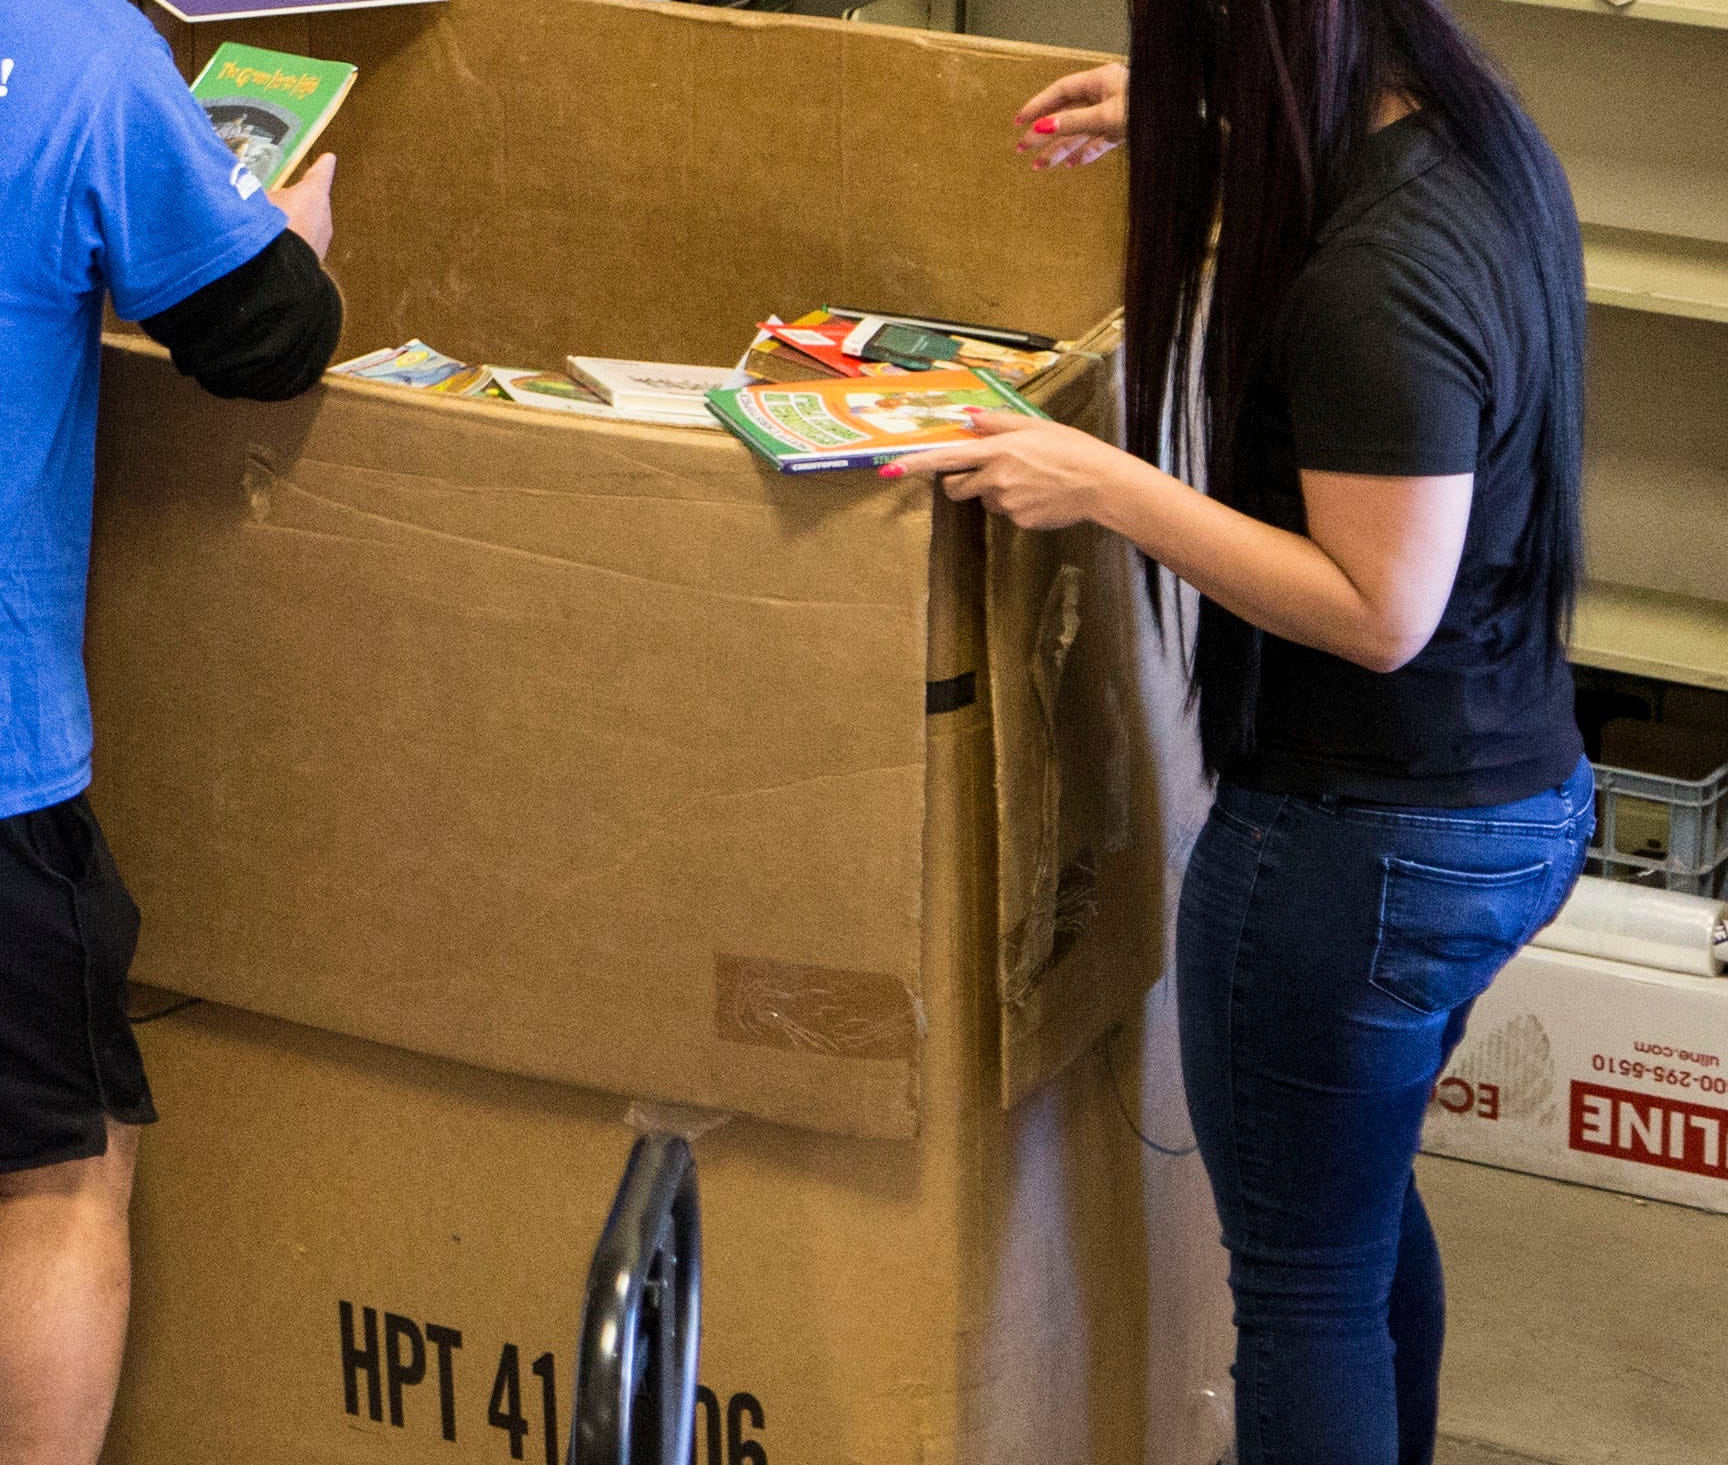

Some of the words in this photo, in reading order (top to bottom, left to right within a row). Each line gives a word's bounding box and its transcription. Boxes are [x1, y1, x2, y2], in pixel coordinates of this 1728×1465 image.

[792, 459, 849, 472] CHRISTOPHER
[1634, 1041, 1720, 1068] uline.com
[1580, 1093, 1720, 1168] LINE
[338, 1300, 463, 1444] HPT
[487, 1342, 559, 1465] 41
